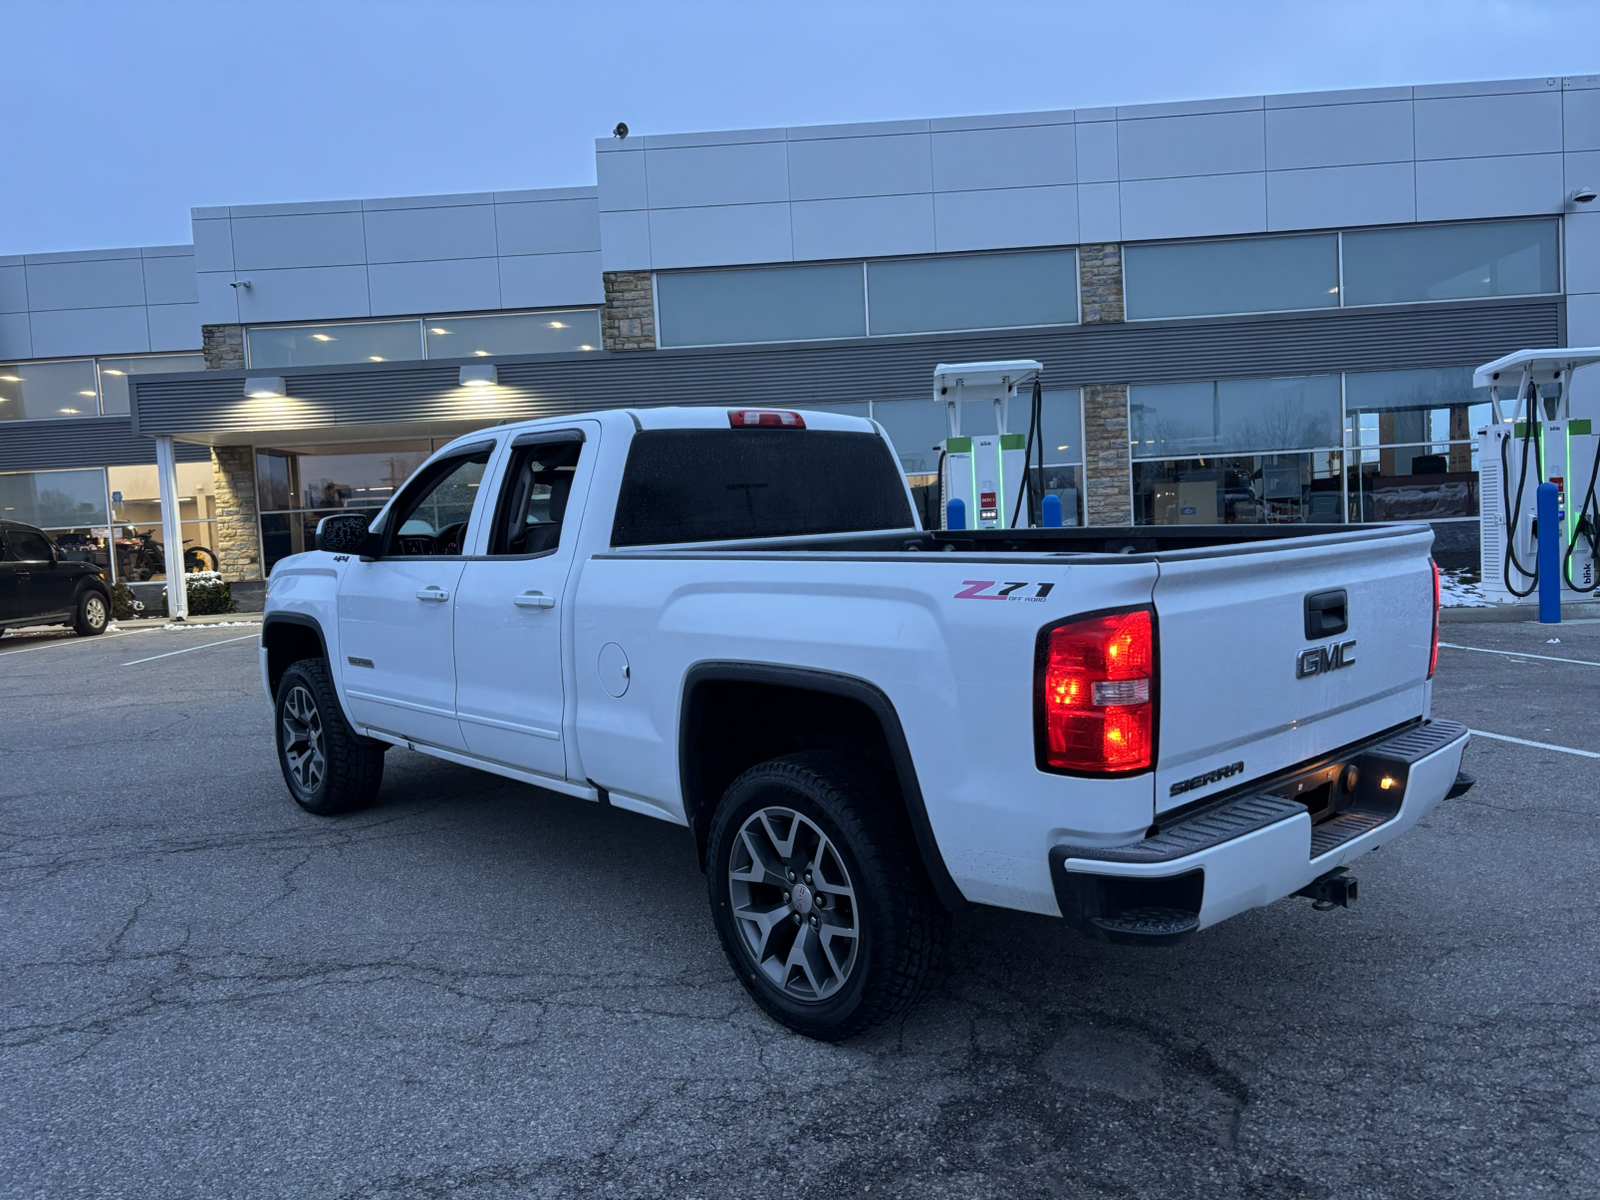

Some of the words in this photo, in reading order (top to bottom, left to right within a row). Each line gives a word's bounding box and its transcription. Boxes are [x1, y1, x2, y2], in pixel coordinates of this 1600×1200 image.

[1583, 563, 1591, 584] blink
[953, 580, 1055, 601] Z71
[1295, 639, 1357, 680] GMC
[1169, 760, 1245, 798] SIERRA
[797, 885, 806, 912] GMC
